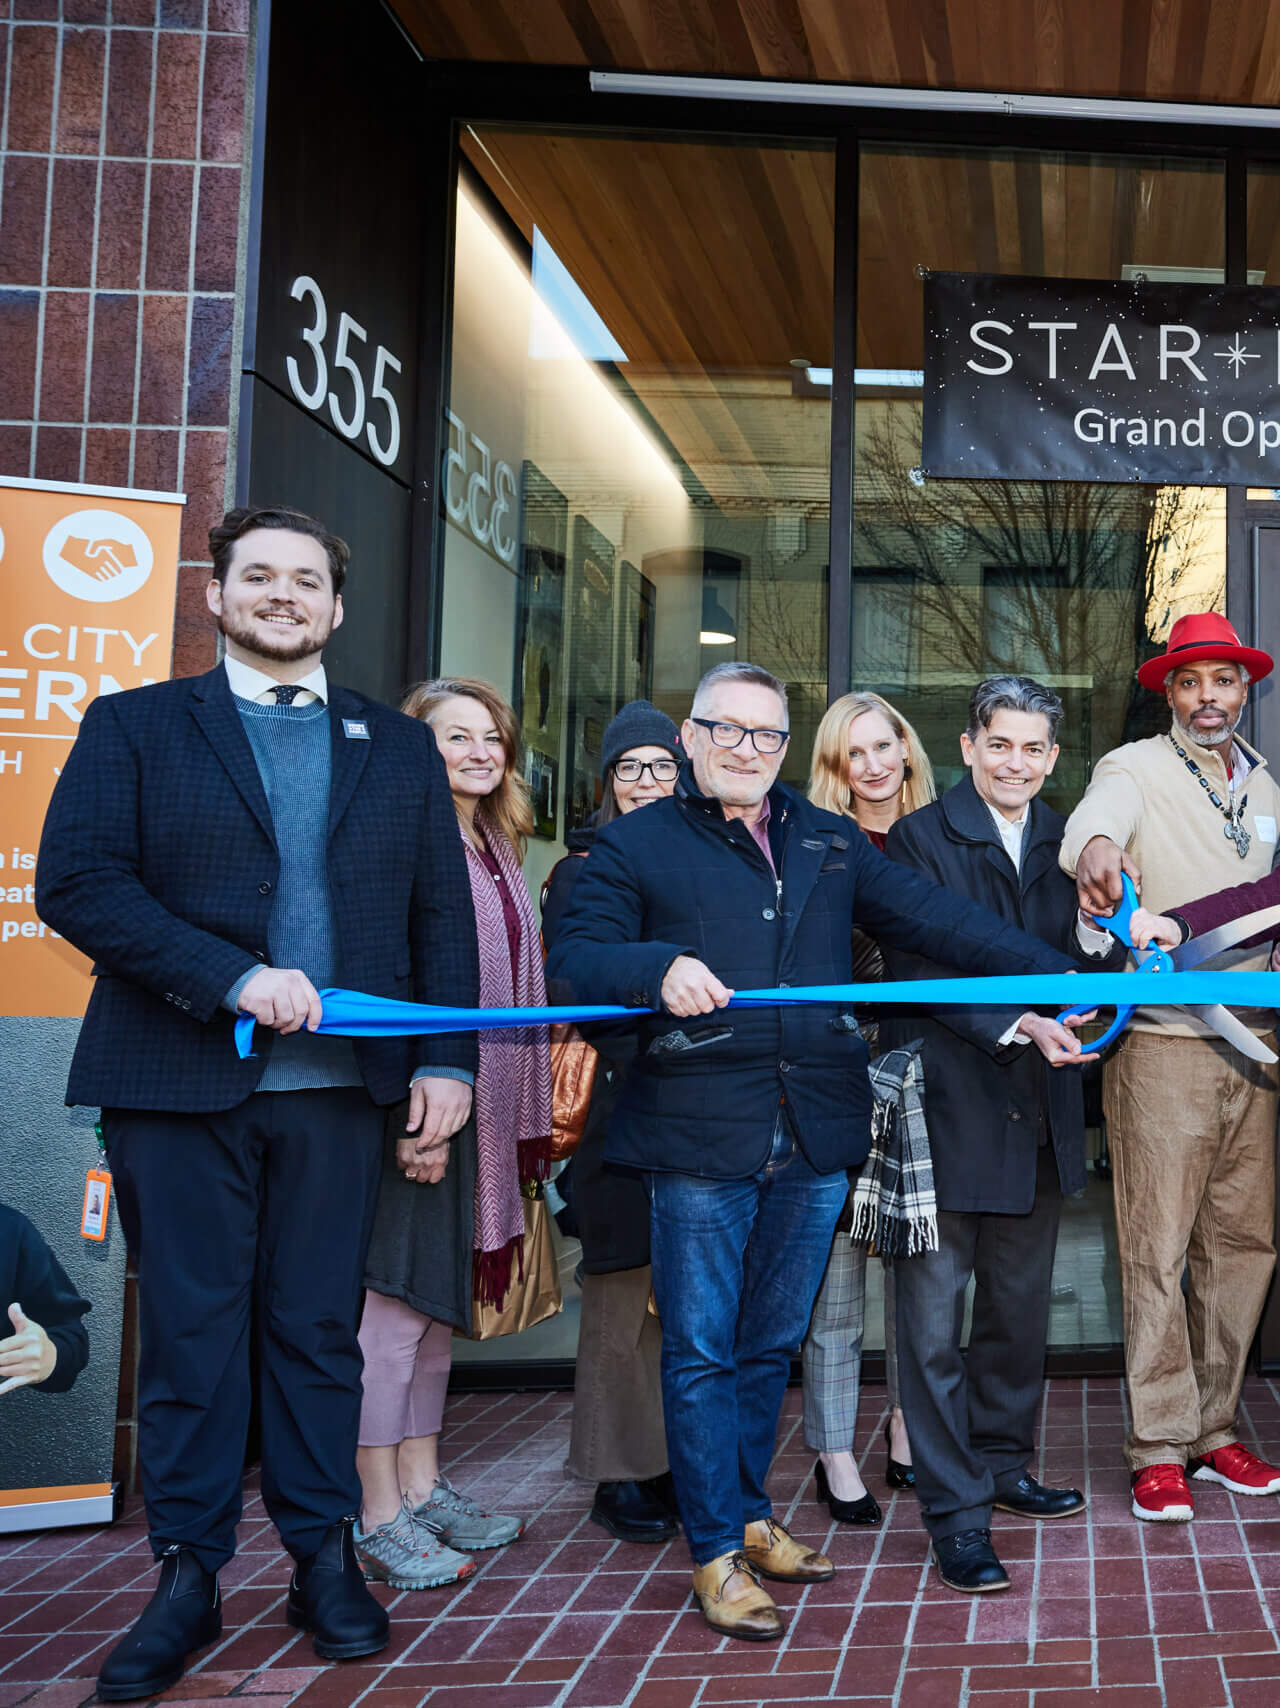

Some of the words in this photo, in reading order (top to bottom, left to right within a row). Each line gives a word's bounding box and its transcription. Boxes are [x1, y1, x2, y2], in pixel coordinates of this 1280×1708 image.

[286, 275, 402, 467] 355
[966, 320, 1208, 382] STAR
[1073, 407, 1205, 447] Grand
[23, 623, 158, 667] CITY
[12, 847, 36, 869] is
[2, 920, 62, 942] per
